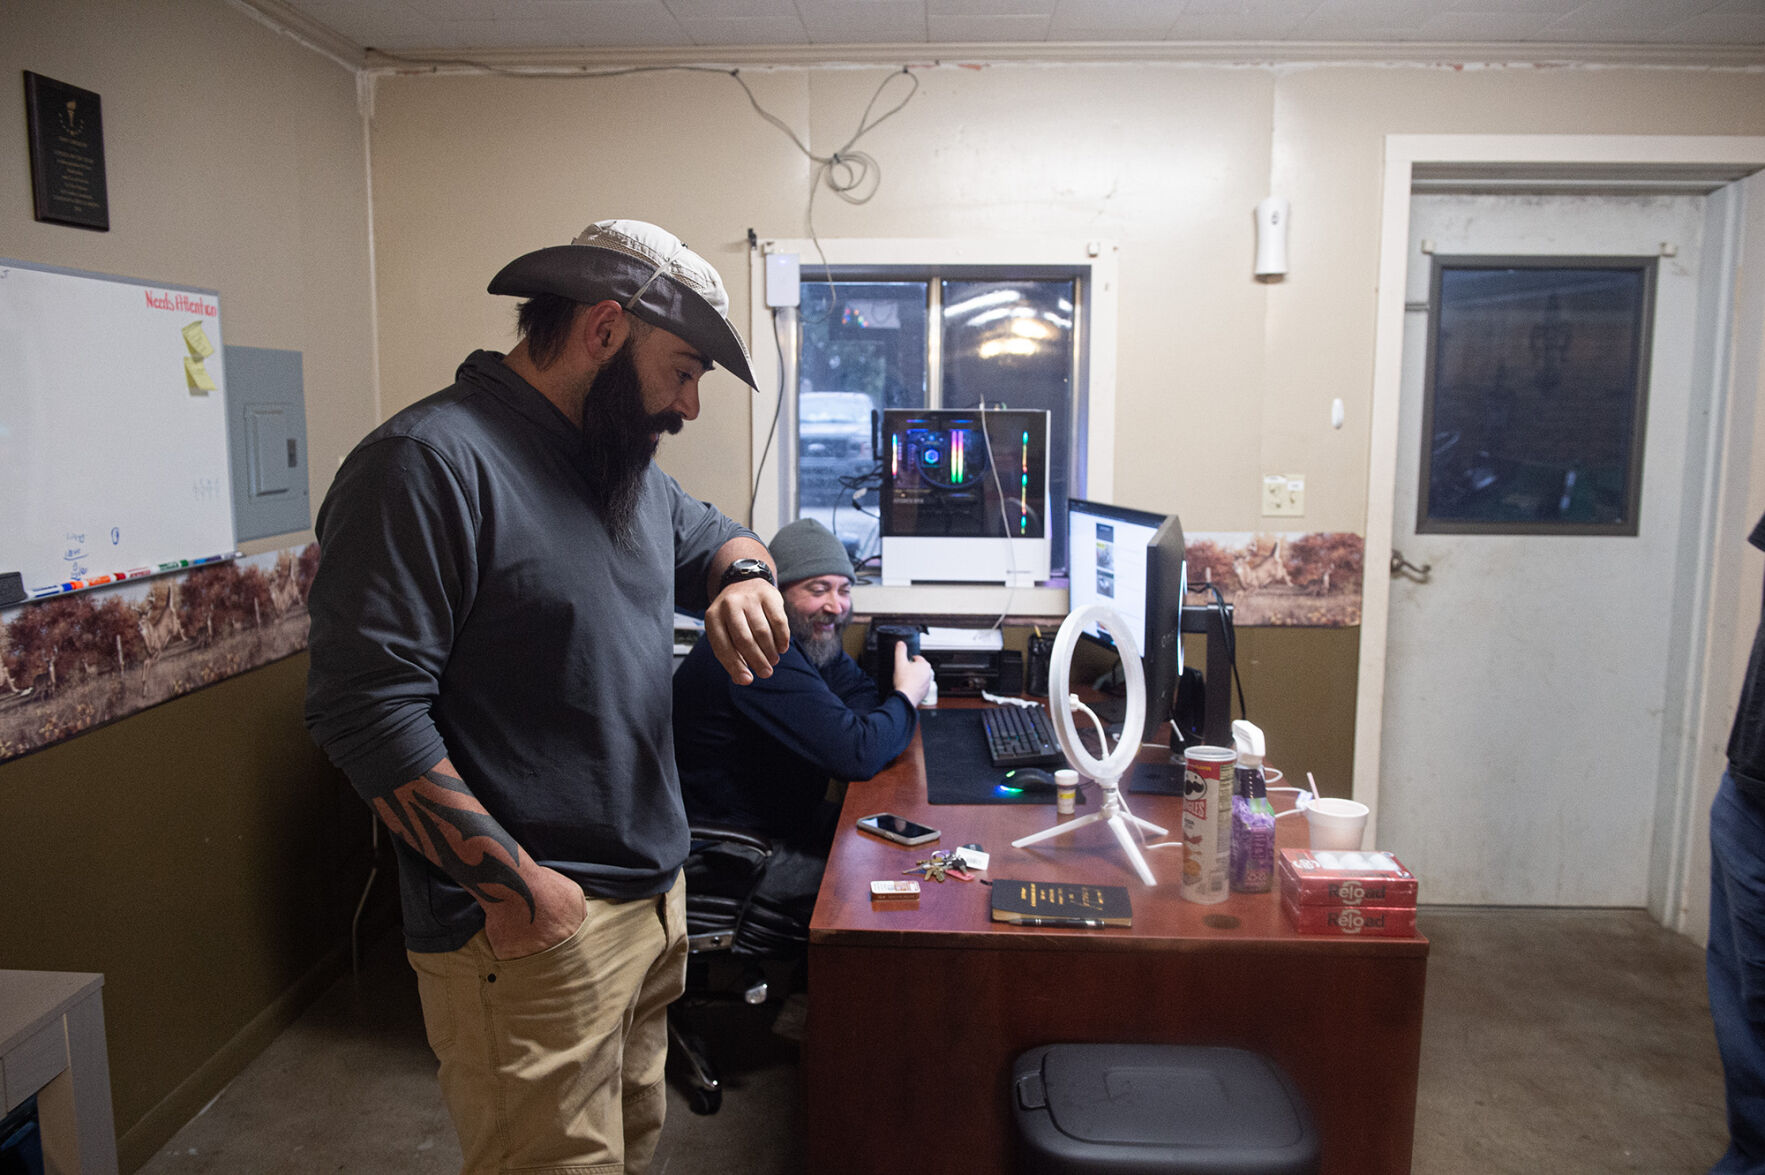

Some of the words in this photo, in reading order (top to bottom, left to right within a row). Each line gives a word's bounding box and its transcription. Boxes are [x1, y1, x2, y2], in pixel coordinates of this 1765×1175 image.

[144, 290, 175, 312] Needs
[175, 294, 217, 317] Attention
[1328, 883, 1386, 900] Reload
[1328, 911, 1385, 928] Reload
